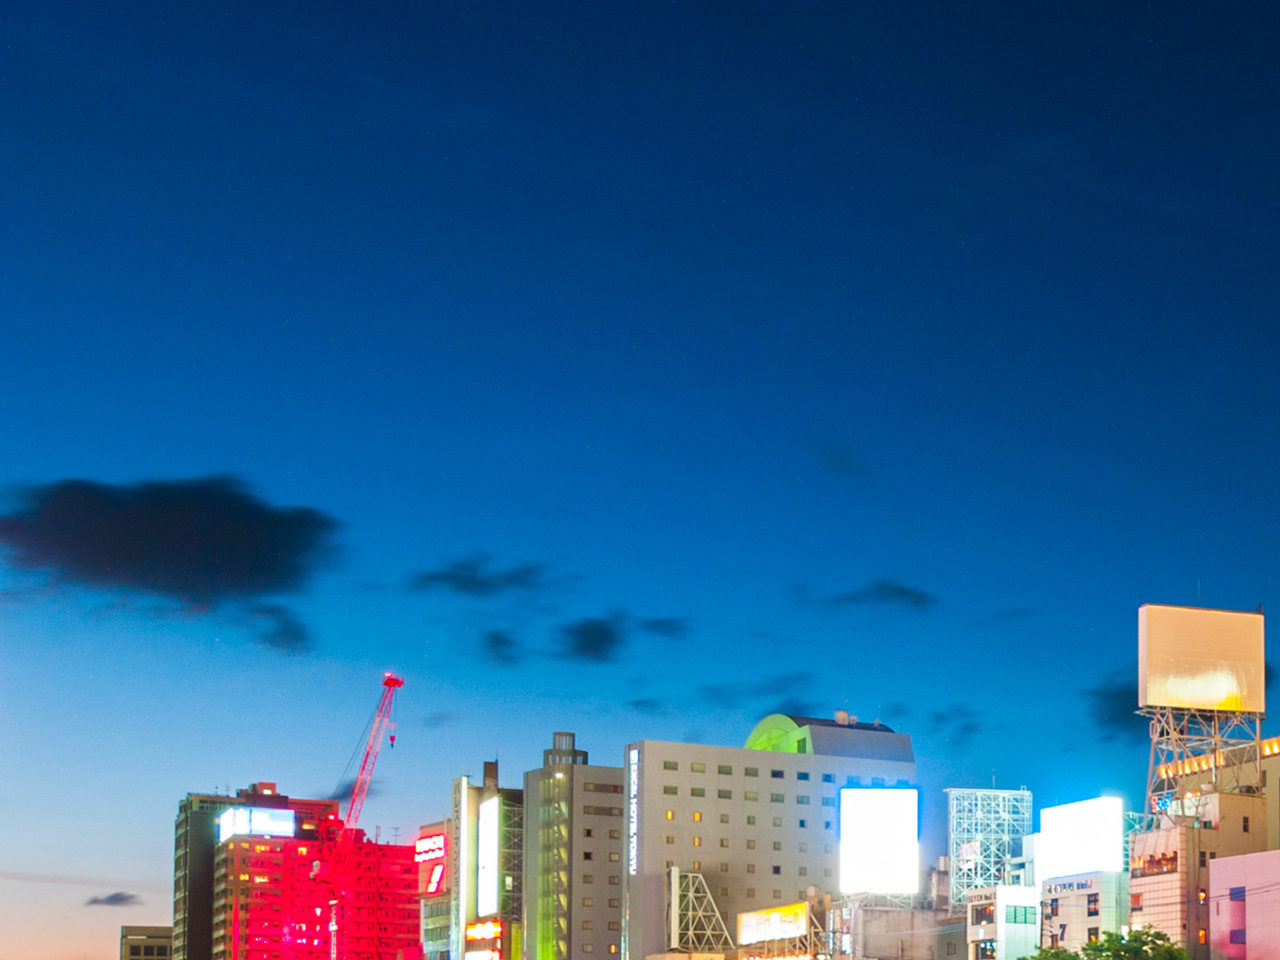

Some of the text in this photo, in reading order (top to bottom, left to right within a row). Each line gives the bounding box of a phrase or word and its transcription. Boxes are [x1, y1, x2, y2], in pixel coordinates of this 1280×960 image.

[629, 764, 638, 875] EXCEL HOTEL TOKYU
[1060, 924, 1067, 941] 7
